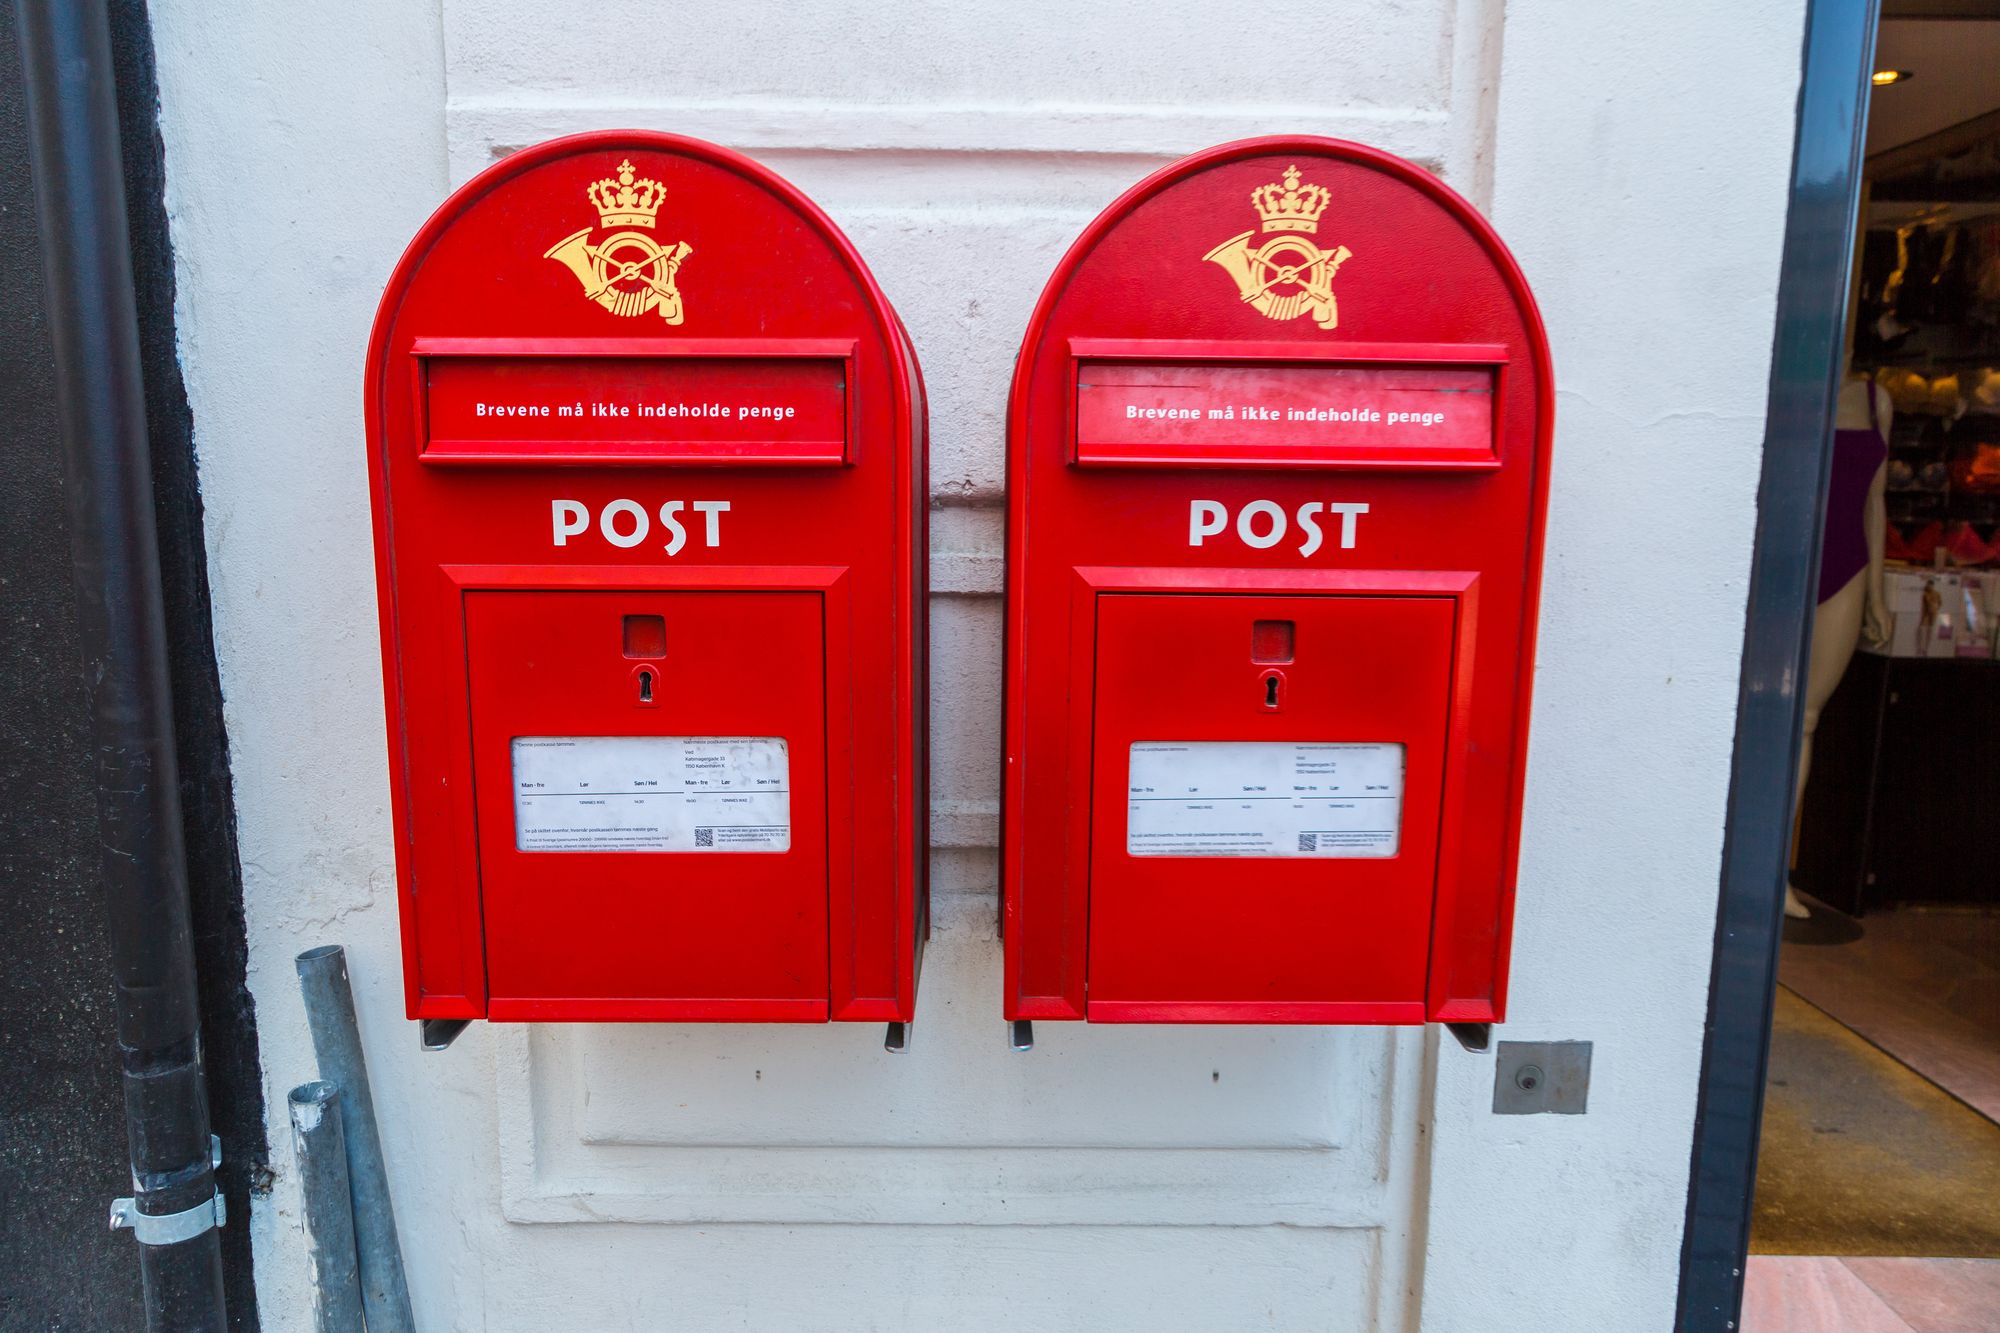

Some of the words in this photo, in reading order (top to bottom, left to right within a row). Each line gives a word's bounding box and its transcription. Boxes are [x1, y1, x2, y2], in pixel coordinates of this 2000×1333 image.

[476, 403, 550, 417] Brevene
[558, 403, 584, 417] må
[592, 403, 630, 417] ikke
[638, 403, 731, 417] indeholde
[739, 406, 795, 421] penge
[1126, 405, 1201, 420] Brevene
[1208, 405, 1235, 420] må
[1241, 406, 1281, 421] ikke
[1287, 407, 1381, 423] indeholde
[1387, 411, 1445, 427] penge
[551, 499, 731, 557] POST
[1189, 500, 1369, 558] POST
